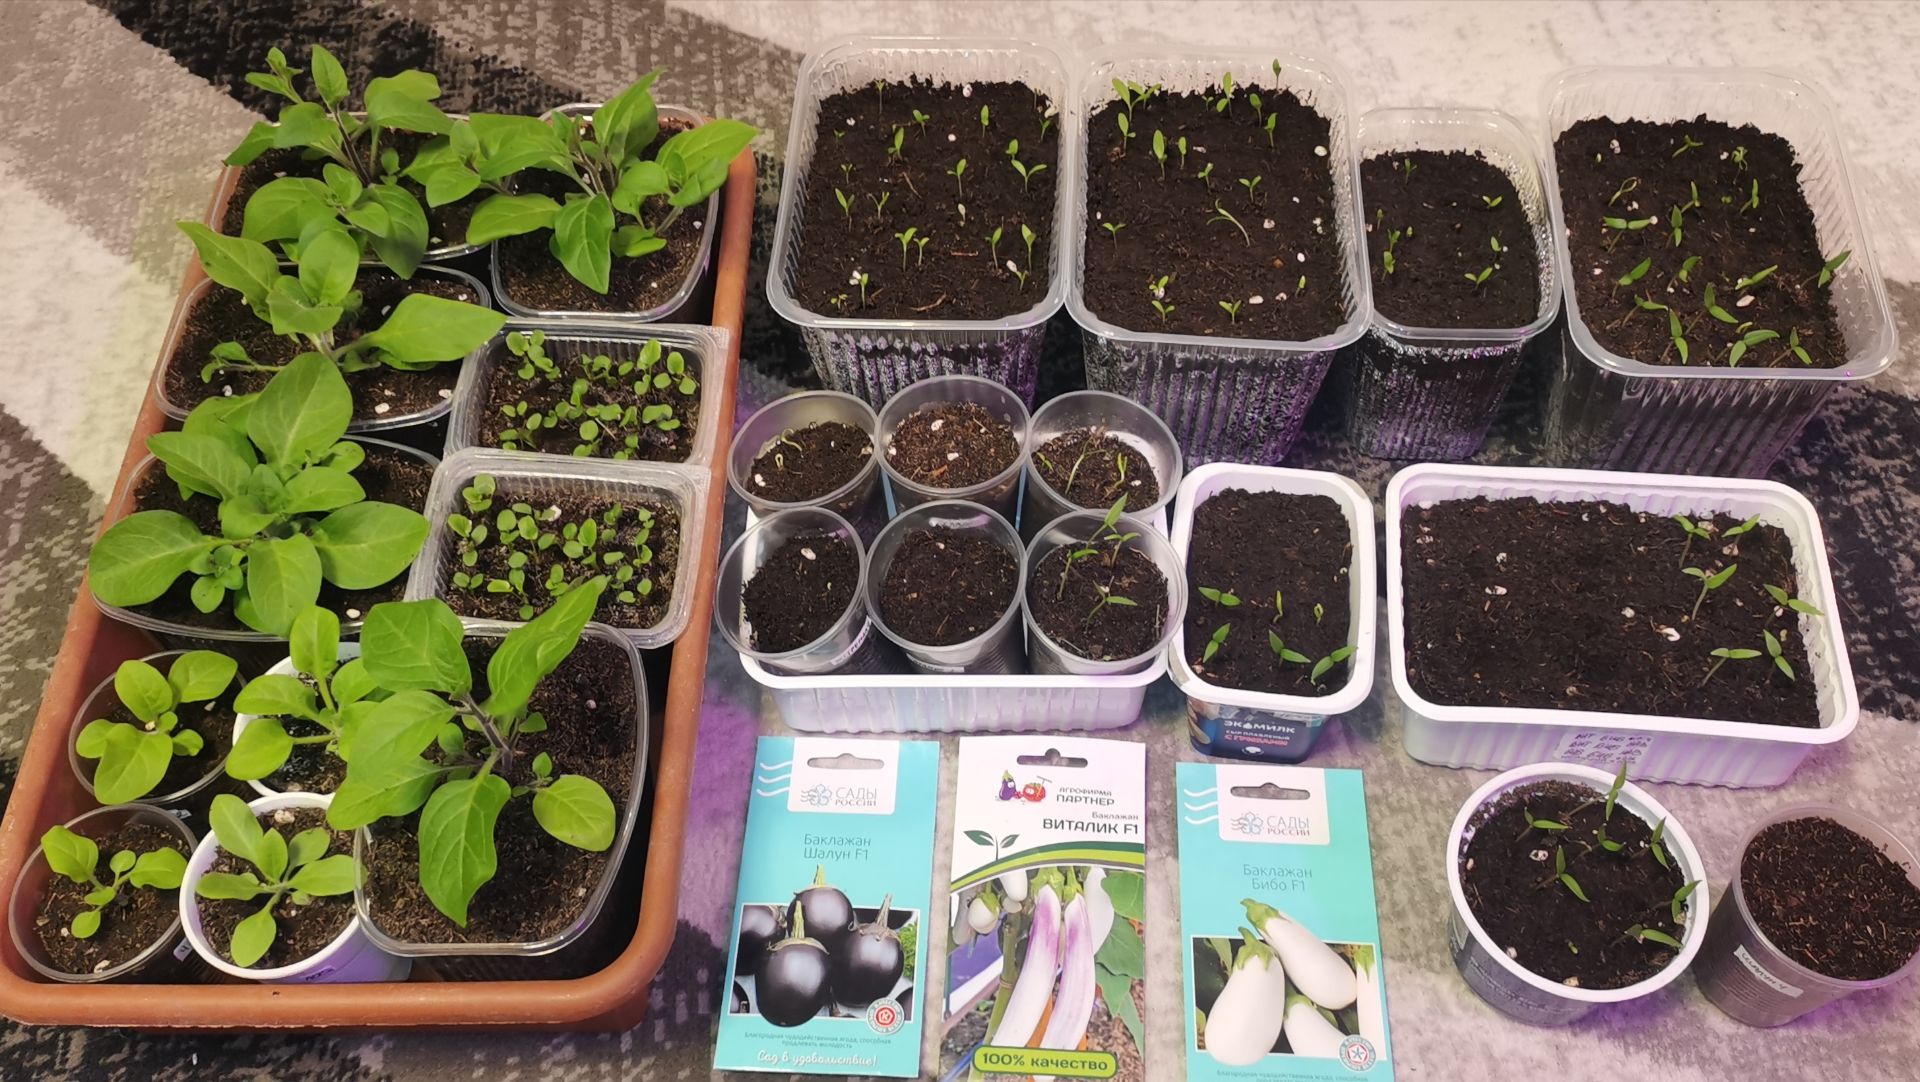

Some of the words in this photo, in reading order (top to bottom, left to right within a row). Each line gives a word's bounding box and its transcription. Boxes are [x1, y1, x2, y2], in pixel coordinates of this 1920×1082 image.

[835, 787, 877, 800] САДЫ
[1059, 787, 1112, 797] АГРОФИРМА
[835, 799, 876, 807] РОССИИ
[1056, 794, 1115, 806] ПАРТНЕР
[1092, 811, 1139, 820] Баклажан
[1266, 815, 1310, 829] САДЫ
[1043, 818, 1118, 834] ВИТАЛИК
[1124, 824, 1138, 835] F1
[1267, 828, 1310, 836] РОССИИ
[804, 833, 871, 847] Баклажан
[803, 847, 851, 861] Шалун
[855, 849, 868, 861] F1
[1243, 863, 1312, 878] Баклажан
[1252, 877, 1287, 891] Бибо
[1292, 880, 1306, 891] F1
[983, 1053, 1025, 1066] 100%
[1031, 1057, 1108, 1071] качество
